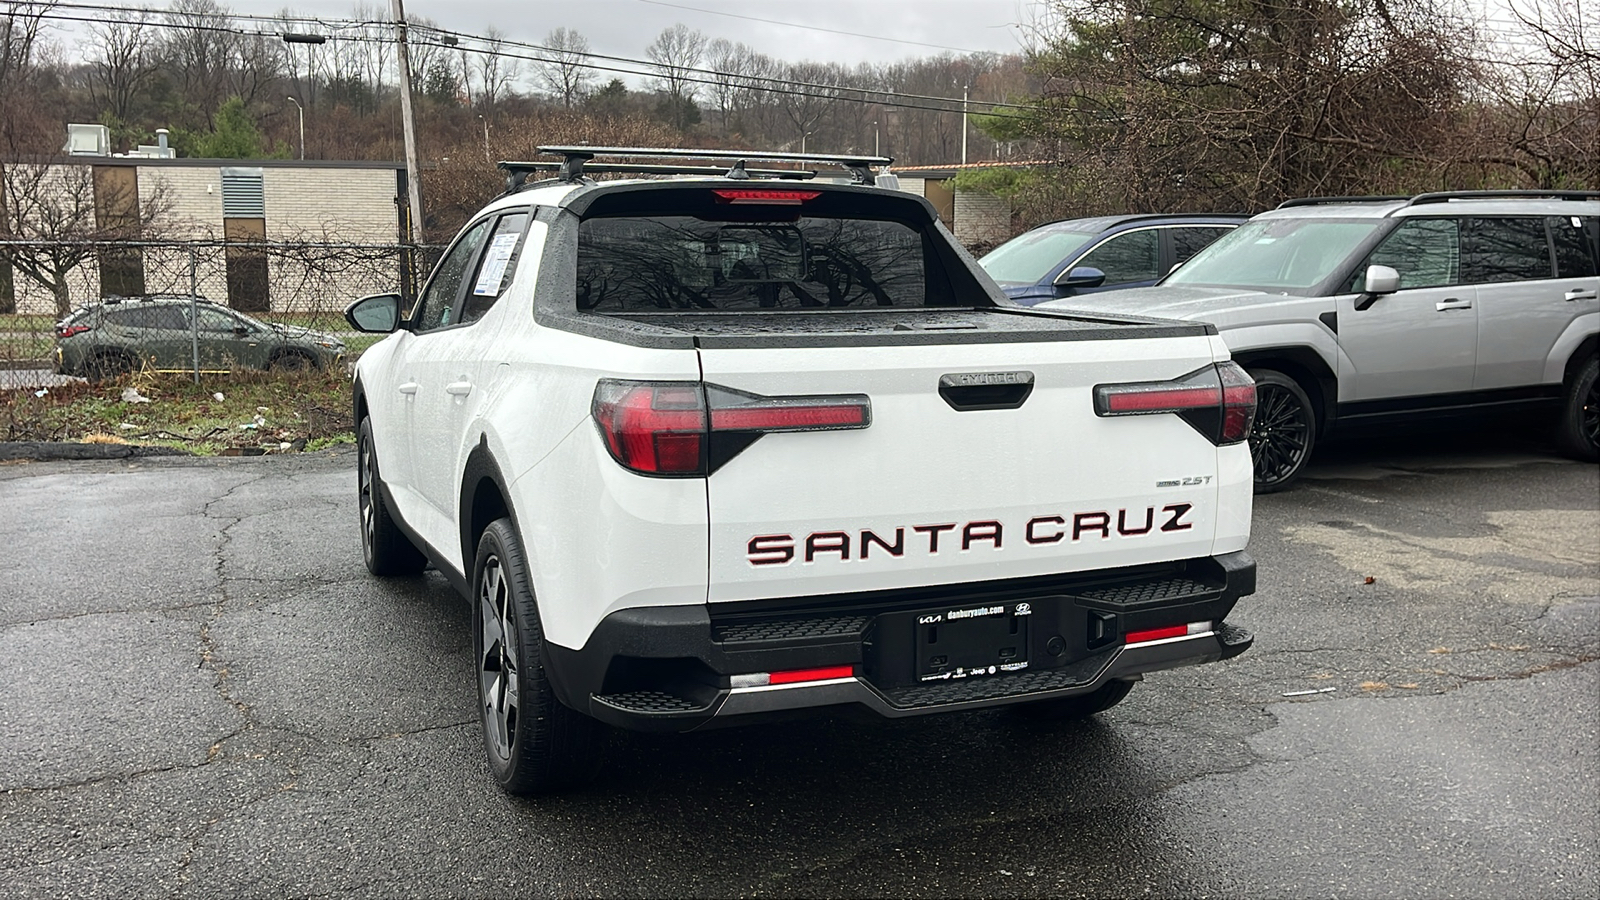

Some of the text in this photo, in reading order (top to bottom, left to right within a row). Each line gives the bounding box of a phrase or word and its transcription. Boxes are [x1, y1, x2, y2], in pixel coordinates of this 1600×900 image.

[960, 373, 1018, 384] HYUNDAI
[747, 501, 1195, 566] SANTA CRUZ
[947, 606, 1004, 619] danburyauto.com
